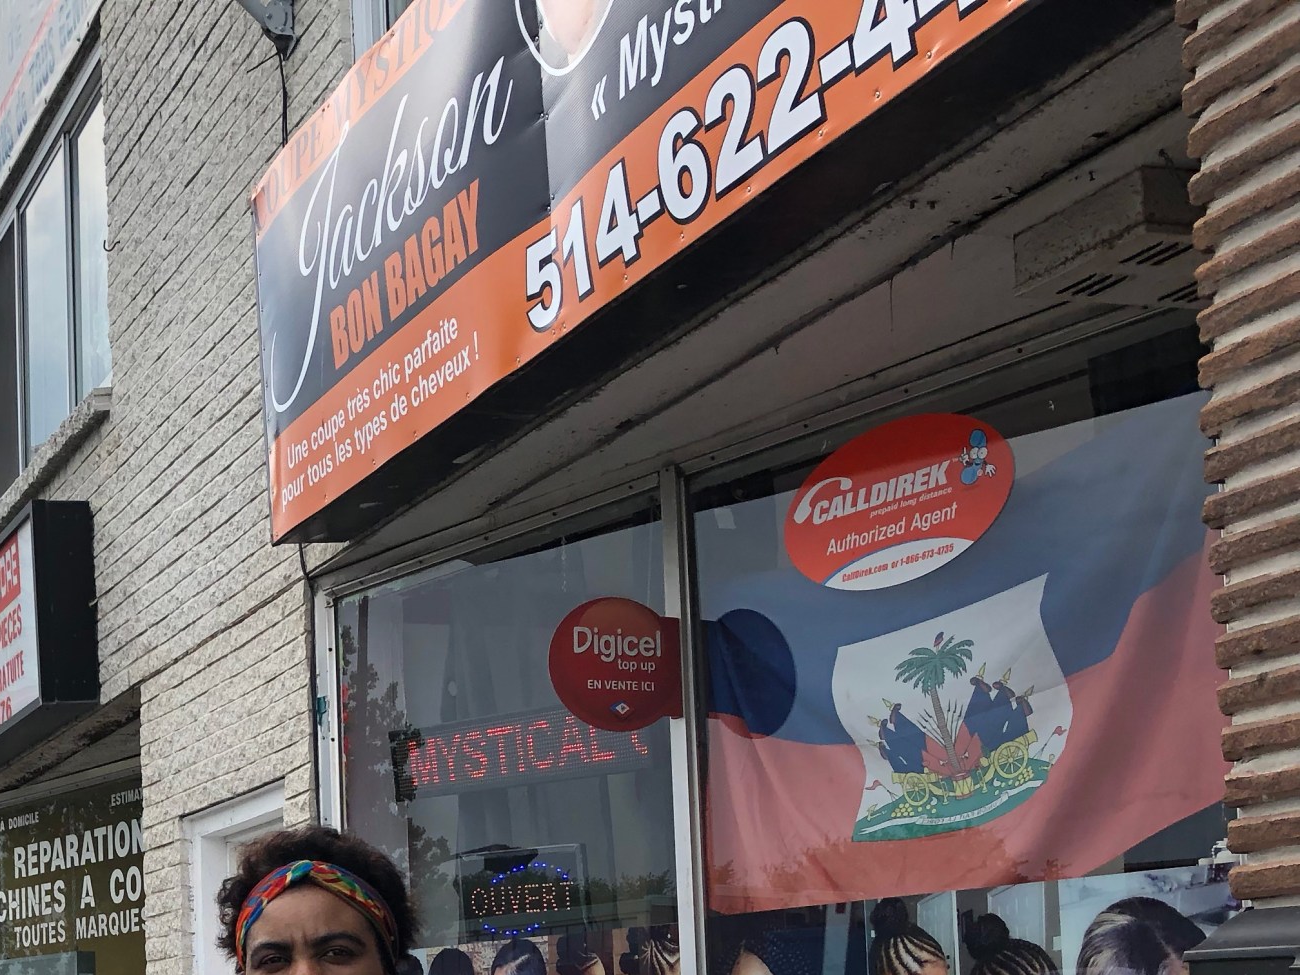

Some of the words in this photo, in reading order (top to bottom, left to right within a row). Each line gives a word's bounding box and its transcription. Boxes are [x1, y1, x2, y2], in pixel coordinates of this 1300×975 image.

[526, 0, 992, 331] 514-622-4
[271, 56, 513, 412] Jackson
[330, 270, 384, 370] BON
[384, 178, 480, 322] BAGAY
[287, 440, 309, 469] Une
[311, 410, 346, 451] coupe
[347, 388, 370, 422] très
[373, 361, 401, 400] chic
[404, 316, 458, 384] parfaite
[282, 474, 305, 513] pour
[307, 453, 333, 487] tous
[335, 438, 352, 467] les
[354, 410, 387, 454] types
[390, 395, 408, 423] de
[410, 345, 471, 407] cheveux
[812, 460, 951, 525] CALLDIREK
[870, 502, 898, 518] prepaid
[919, 487, 953, 502] distance
[826, 517, 906, 556] Authorized
[910, 501, 958, 532] Agent
[891, 560, 899, 569] or
[573, 626, 661, 662] Digicel
[618, 659, 637, 672] top
[641, 661, 655, 673] up
[587, 679, 601, 689] EN
[605, 680, 638, 691] VENTE
[642, 681, 655, 691] ICI
[407, 714, 616, 786] MYSTICAL
[9, 812, 39, 830] DOMICILE
[13, 819, 144, 879] RÉPARATION
[80, 868, 96, 909] À
[110, 866, 142, 904] CO
[471, 881, 574, 916] OUVERT
[14, 920, 66, 949] TOUTES
[76, 907, 148, 940] MARQUES
